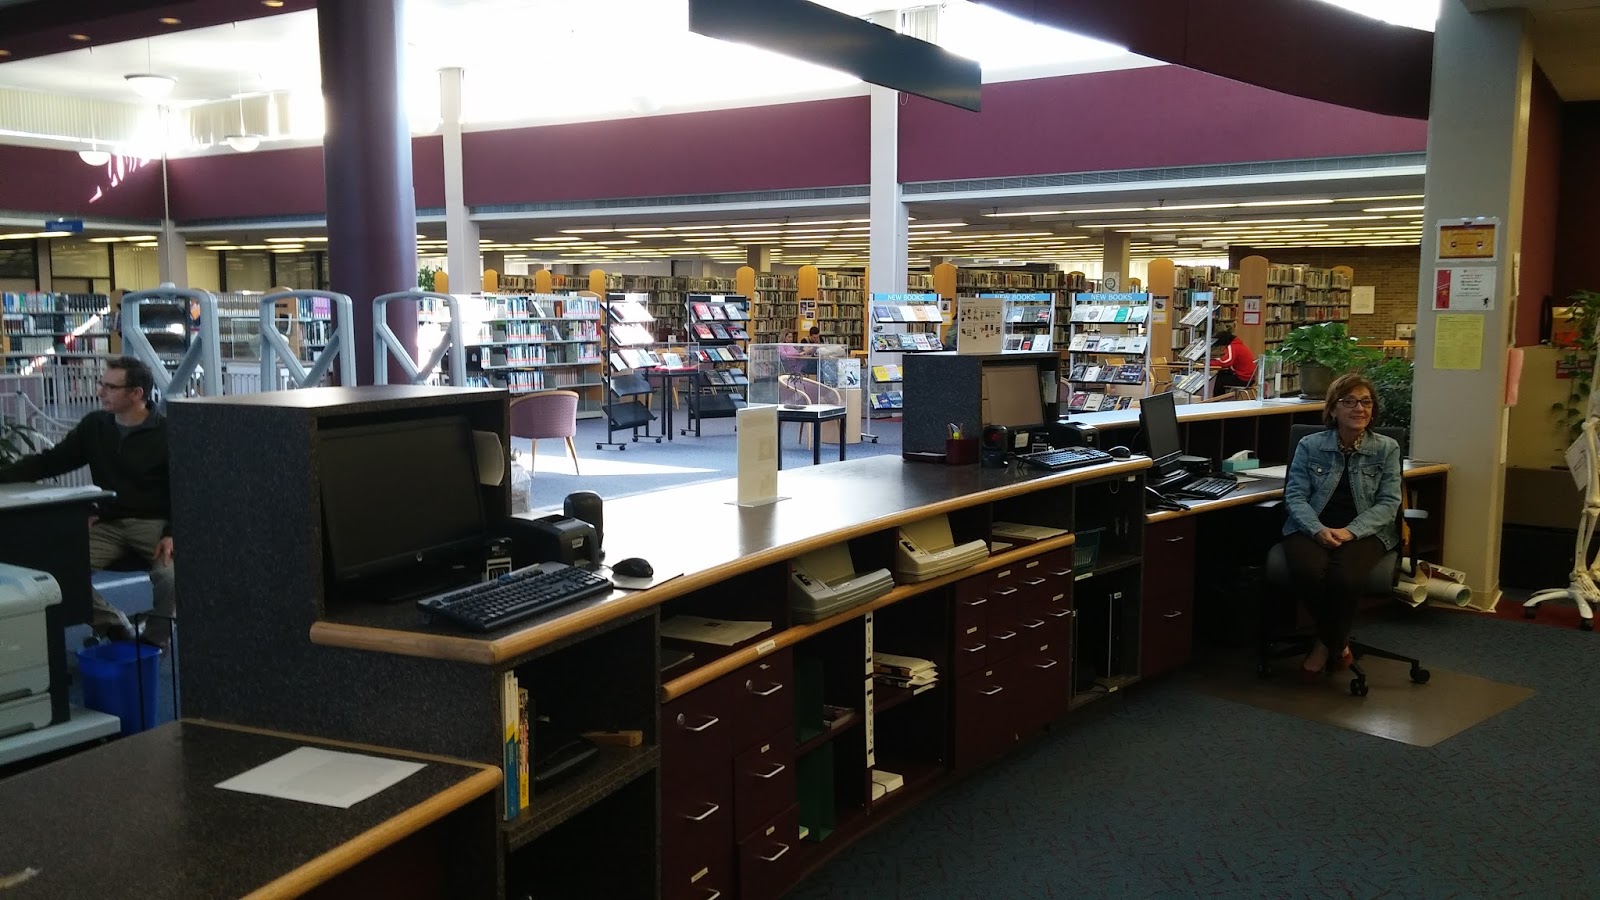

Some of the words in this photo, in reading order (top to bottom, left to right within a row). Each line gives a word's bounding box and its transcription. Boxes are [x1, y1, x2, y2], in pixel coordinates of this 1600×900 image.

[1011, 293, 1036, 301] BOOKS
[1090, 293, 1107, 301] NEW
[1108, 293, 1133, 301] BOOKS
